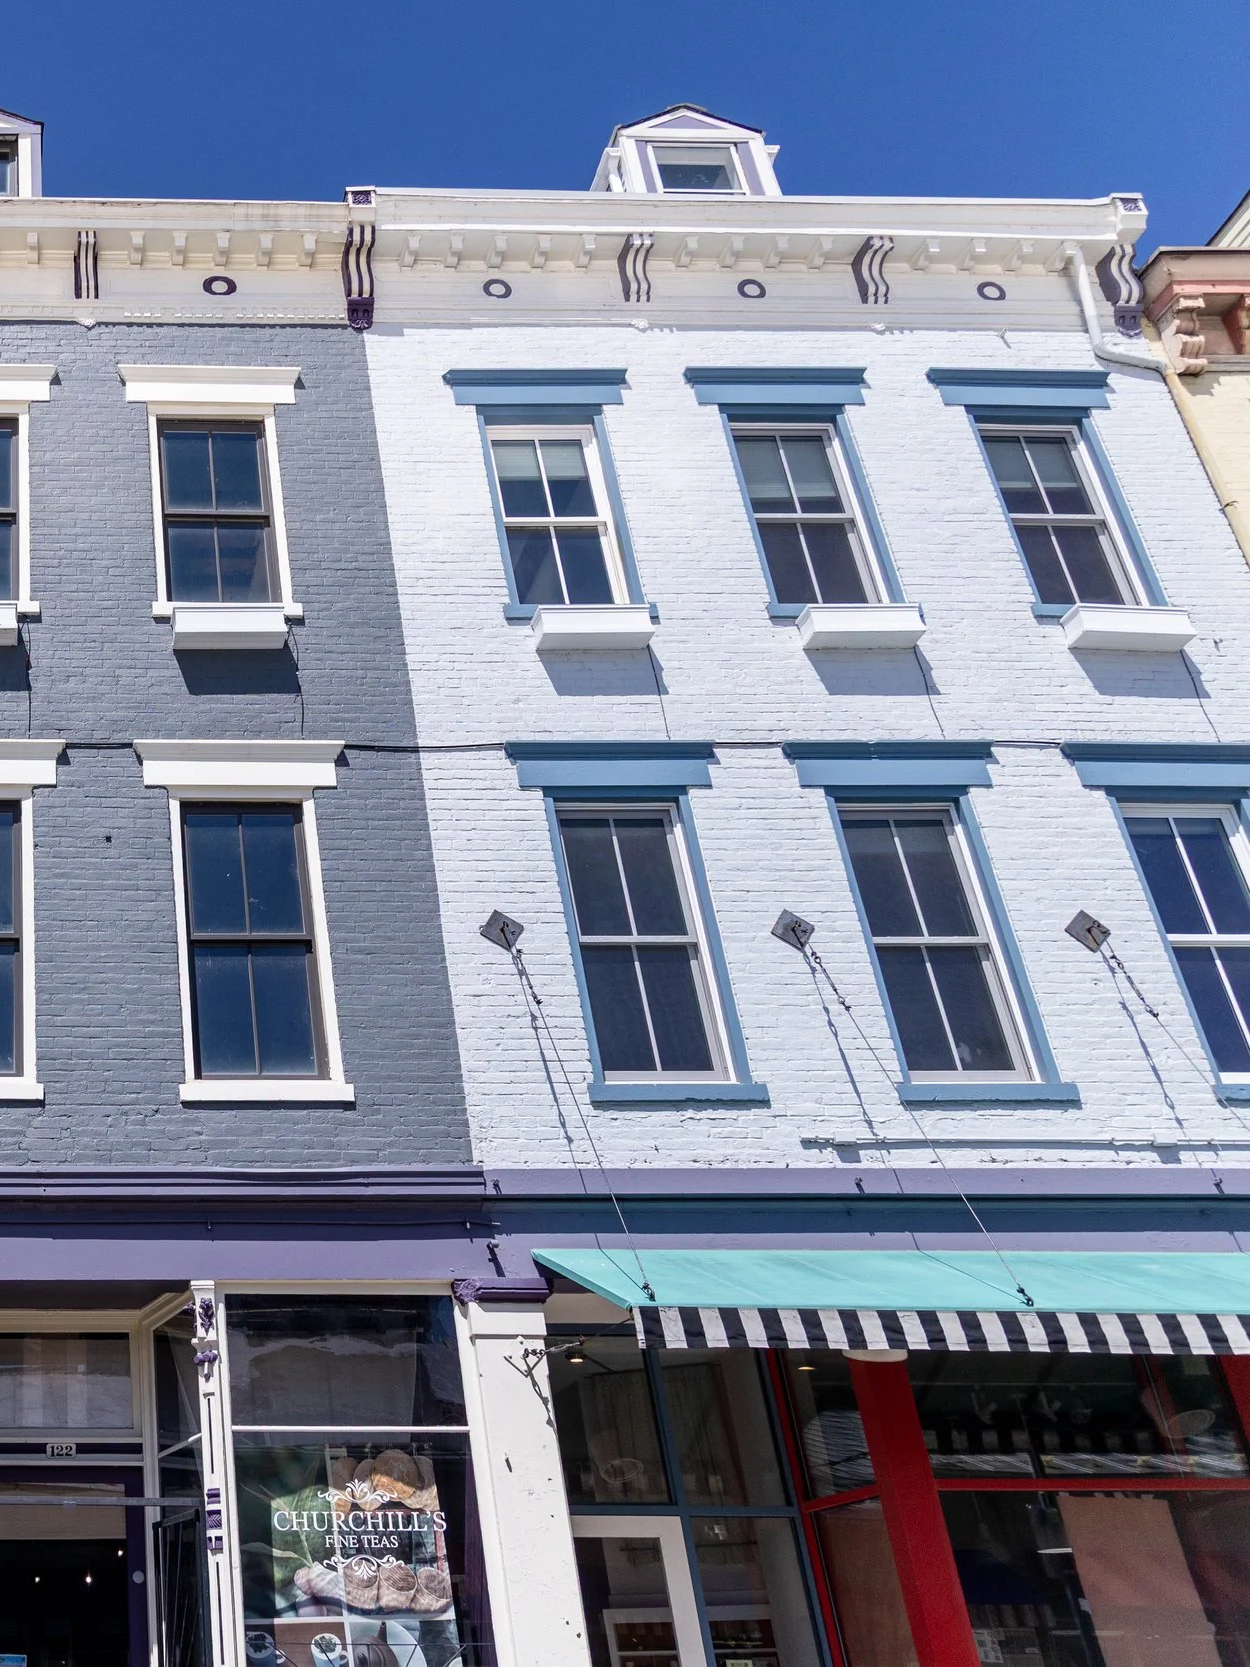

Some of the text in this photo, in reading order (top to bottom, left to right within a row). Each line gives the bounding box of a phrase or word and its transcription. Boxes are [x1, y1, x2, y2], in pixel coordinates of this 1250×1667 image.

[50, 1445, 73, 1457] 122
[273, 1510, 447, 1532] CHURCHILL'S
[325, 1535, 399, 1548] FINE TEAS
